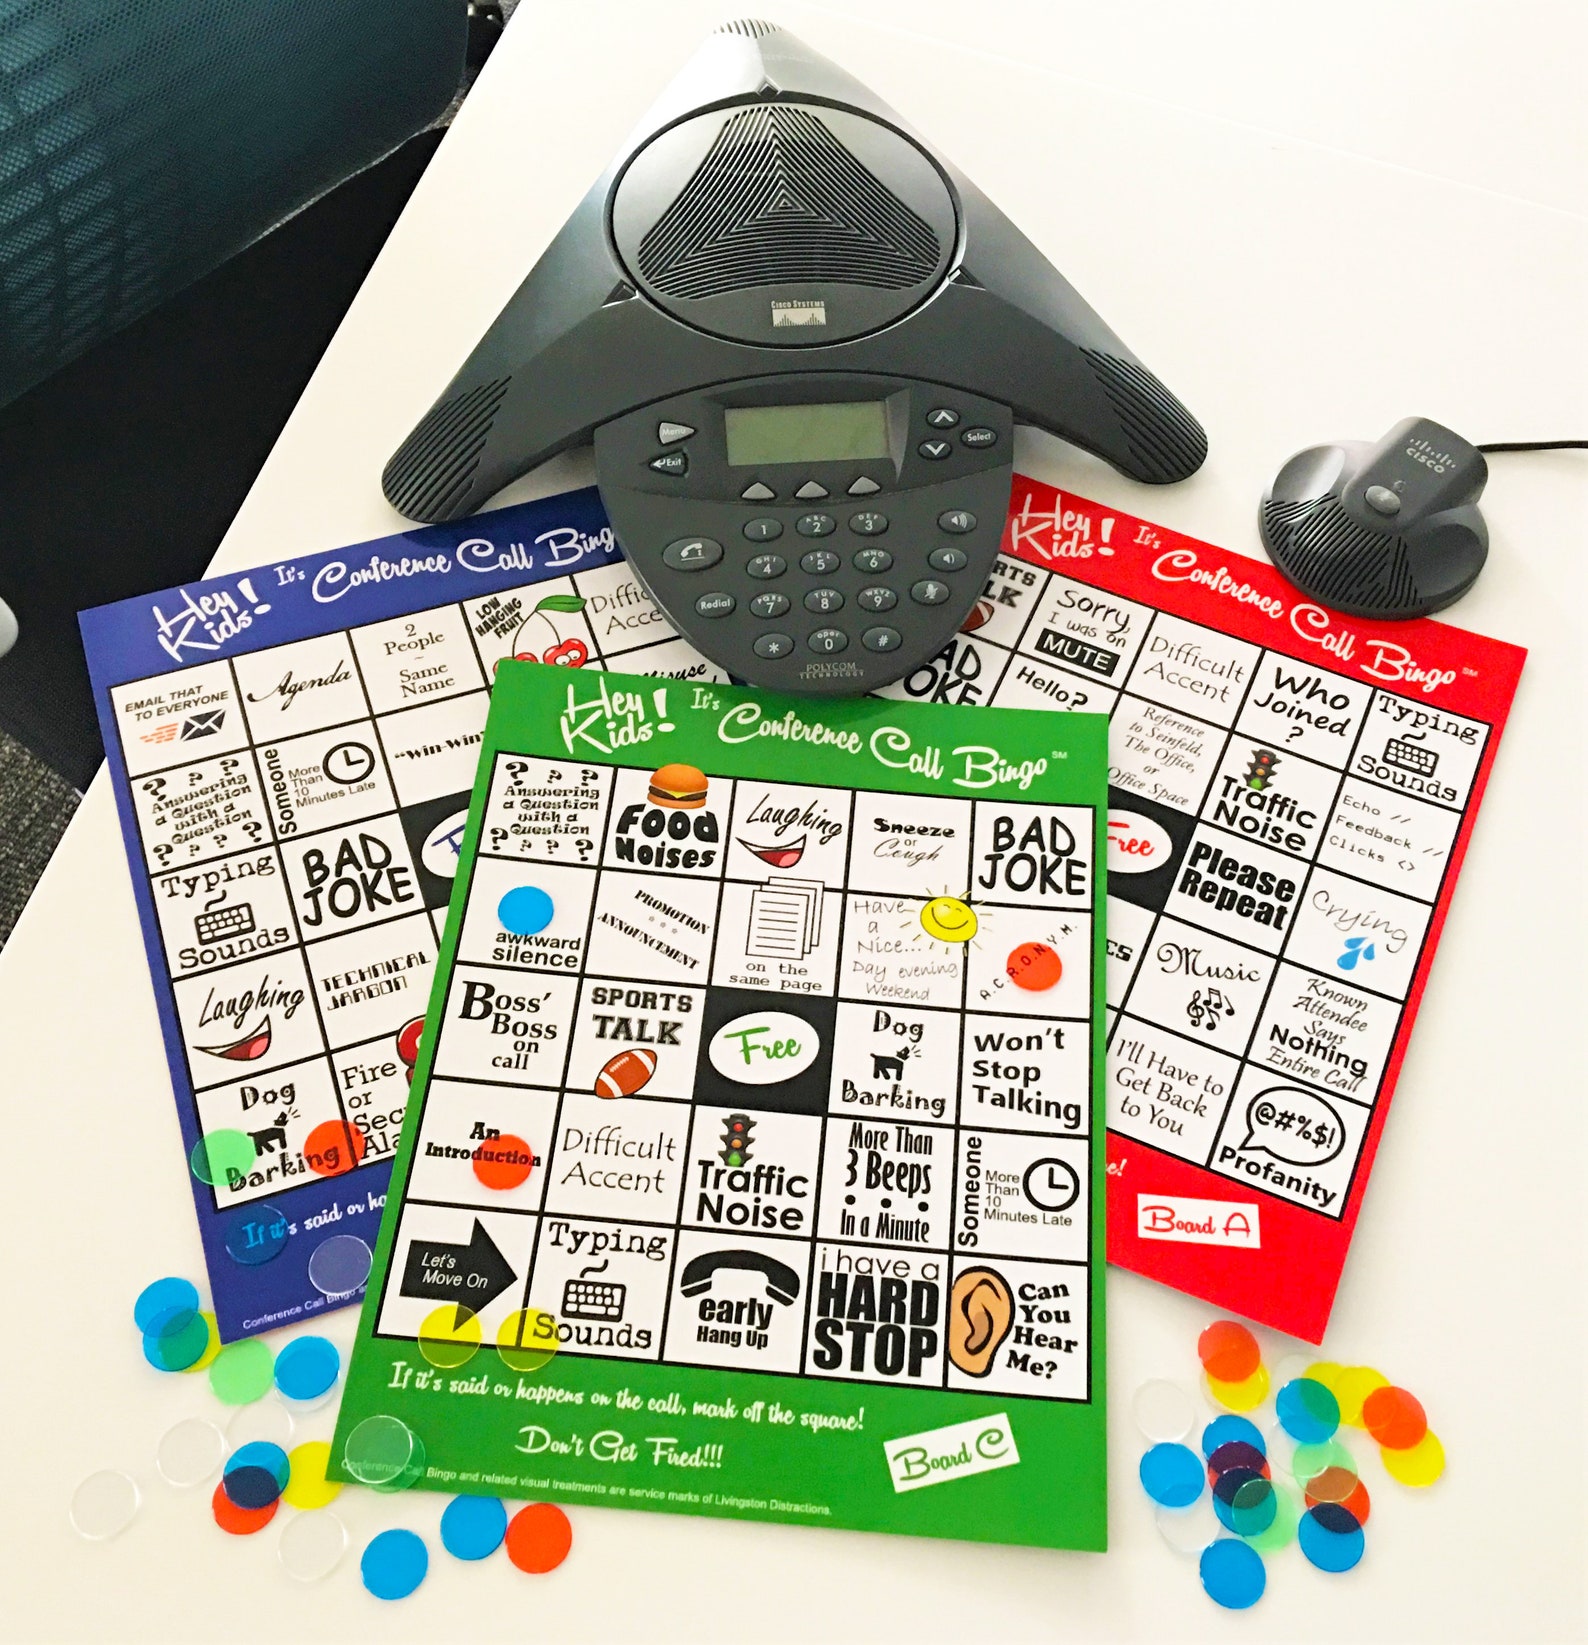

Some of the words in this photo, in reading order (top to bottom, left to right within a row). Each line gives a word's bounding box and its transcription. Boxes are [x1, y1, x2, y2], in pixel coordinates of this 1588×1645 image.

[662, 426, 686, 437] Menu
[967, 432, 991, 442] Select
[667, 457, 682, 467] Exit
[812, 522, 821, 534] 2
[865, 519, 874, 531] 3
[274, 565, 305, 586] It's
[312, 555, 451, 603] Conference
[456, 539, 533, 572] Call
[869, 555, 878, 568] 6
[700, 599, 731, 610] Redial
[820, 597, 829, 610] 8
[874, 595, 882, 608] 9
[1057, 590, 1130, 634] Sorry,
[1134, 526, 1161, 549] It's
[1151, 549, 1284, 619] Conference
[1289, 604, 1355, 661] Call
[1361, 640, 1456, 692] Bingo
[384, 632, 445, 655] People
[824, 638, 834, 651] 0
[1044, 634, 1112, 671] MUTE
[399, 664, 447, 683] Same
[806, 663, 856, 672] POLYCOM
[125, 693, 166, 712] EMAIL
[169, 685, 203, 701] THAT
[247, 660, 352, 711] Agenda
[401, 676, 455, 698] Name
[564, 676, 645, 724] Hey
[1016, 667, 1088, 711] Hello?
[1275, 666, 1350, 710] Who
[135, 710, 153, 722] TO
[156, 690, 230, 718] EVERYONE
[1254, 693, 1351, 737] Joined
[1379, 694, 1479, 745] Typing
[691, 688, 720, 710] It's
[717, 702, 863, 755] Conference
[870, 726, 944, 780] Call
[952, 746, 1048, 790] Bingo
[265, 748, 297, 835] Someone
[504, 786, 600, 799] Answering
[1357, 754, 1458, 802] Sounds
[518, 812, 561, 822] with
[520, 799, 599, 810] Question
[746, 793, 842, 845] Laughing
[1343, 795, 1380, 816] Echo
[510, 824, 589, 834] Question
[616, 804, 719, 843] Food
[873, 818, 955, 838] Sneeze
[992, 816, 1076, 857] BAD
[1336, 815, 1412, 849] Feedback
[615, 837, 717, 869] Noises
[873, 838, 944, 868] Cough
[1329, 835, 1385, 862] Clicks
[978, 853, 1087, 896] JOKE
[1188, 841, 1296, 901] Please
[634, 889, 710, 935] PROMOTION
[854, 900, 905, 913] Have
[1178, 868, 1288, 931] Repeat
[1313, 891, 1408, 953] Crying
[492, 945, 578, 968] silence
[496, 932, 581, 951] awkward
[597, 913, 699, 970] ANNOUNCEMENT
[321, 952, 431, 992] TECHNICAL
[746, 962, 766, 972] on
[778, 962, 808, 976] the
[852, 960, 886, 978] Day
[899, 961, 958, 980] evening
[1156, 942, 1261, 983] Music
[327, 975, 408, 1011] JARGON
[729, 974, 770, 987] same
[781, 977, 822, 992] page
[866, 983, 930, 1000] Weekend
[199, 975, 305, 1029] Laughing
[458, 980, 551, 1020] Boss'
[592, 987, 693, 1013] SPORTS
[491, 1012, 557, 1040] Boss
[592, 1014, 684, 1045] TALK
[873, 1010, 924, 1042] Dog
[974, 1028, 1065, 1052] Won't
[513, 1040, 539, 1053] on
[724, 1026, 802, 1065] Free
[1270, 1024, 1368, 1077] Nothing
[491, 1054, 528, 1070] call
[972, 1060, 1041, 1086] Stop
[842, 1079, 946, 1118] Barking
[972, 1085, 1082, 1129] Talking
[425, 1142, 541, 1167] Introduction
[562, 1125, 677, 1162] Difficult
[848, 1122, 888, 1151] More
[894, 1126, 933, 1155] Than
[561, 1162, 665, 1193] Accent
[697, 1159, 809, 1198] Traffic
[845, 1149, 857, 1187] 3
[865, 1149, 932, 1198] Beeps
[985, 1170, 1020, 1184] More
[1219, 1145, 1338, 1208] Profanity
[958, 1136, 982, 1247] Someone
[695, 1192, 804, 1231] Noise
[875, 1212, 930, 1243] Minute
[984, 1208, 1038, 1224] Minutes
[1043, 1213, 1072, 1227] Late
[1142, 1205, 1215, 1234] Board
[1223, 1212, 1251, 1238] A
[549, 1221, 667, 1261] Typing
[422, 1252, 456, 1268] Let's
[836, 1250, 912, 1279] have
[422, 1270, 463, 1286] Move
[466, 1274, 488, 1289] On
[1018, 1282, 1070, 1302] Can
[698, 1297, 773, 1330] early
[817, 1272, 939, 1328] HARD
[1019, 1305, 1071, 1324] You
[533, 1312, 652, 1349] Sounds
[697, 1326, 741, 1348] Hang
[746, 1330, 768, 1350] Up
[1012, 1327, 1079, 1354] Hear
[813, 1318, 938, 1378] STOP
[1005, 1349, 1058, 1380] Me?
[388, 1361, 414, 1389] If
[415, 1371, 442, 1392] it's
[449, 1375, 488, 1395] said
[494, 1384, 512, 1397] or
[515, 1378, 584, 1406] happens
[590, 1392, 612, 1406] on
[616, 1388, 643, 1411] the
[647, 1392, 687, 1415] call,
[693, 1400, 738, 1419] mark
[742, 1400, 763, 1422] off
[768, 1403, 796, 1425] the
[800, 1407, 865, 1433] square!
[514, 1426, 584, 1456] Don't
[590, 1430, 638, 1464] Get
[645, 1437, 723, 1469] Fired!!!
[893, 1447, 973, 1481] Board
[976, 1428, 1009, 1460] C
[427, 1467, 456, 1480] Bingo
[481, 1475, 517, 1486] related
[520, 1477, 549, 1489] visual
[552, 1480, 605, 1495] treatments
[628, 1487, 666, 1501] service
[667, 1489, 699, 1503] marks
[715, 1494, 768, 1509] Livingston
